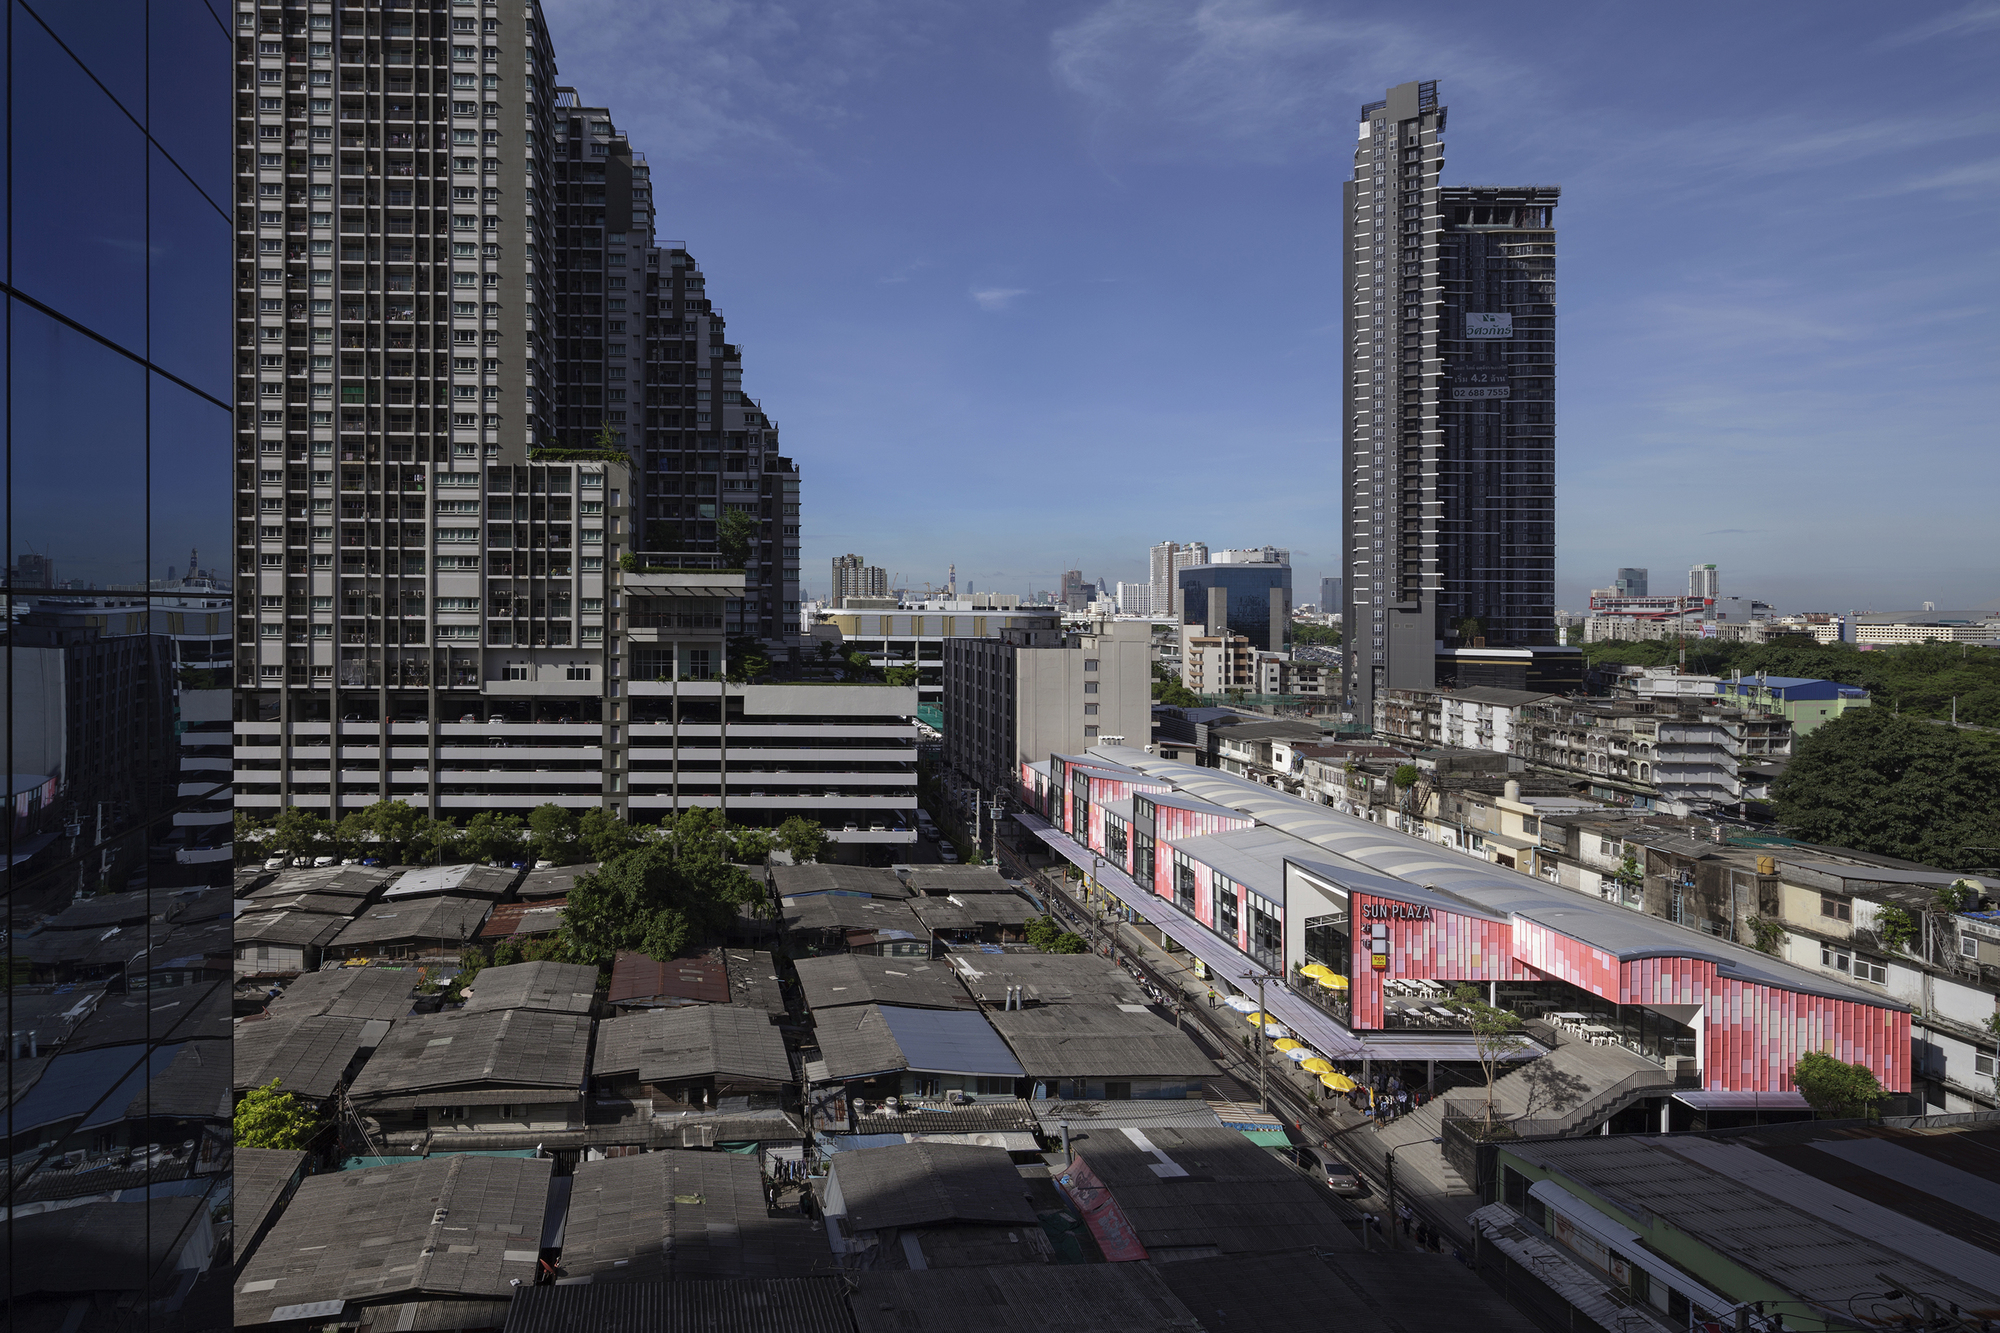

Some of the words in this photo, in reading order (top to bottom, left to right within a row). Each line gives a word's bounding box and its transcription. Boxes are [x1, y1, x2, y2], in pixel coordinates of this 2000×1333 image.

[1470, 373, 1488, 383] 4.2
[1454, 389, 1466, 397] 02
[1468, 389, 1485, 397] 688
[1487, 388, 1509, 396] 7555
[1362, 903, 1388, 918] SUN
[1391, 904, 1431, 919] PLAZA
[1361, 923, 1371, 932] 2F
